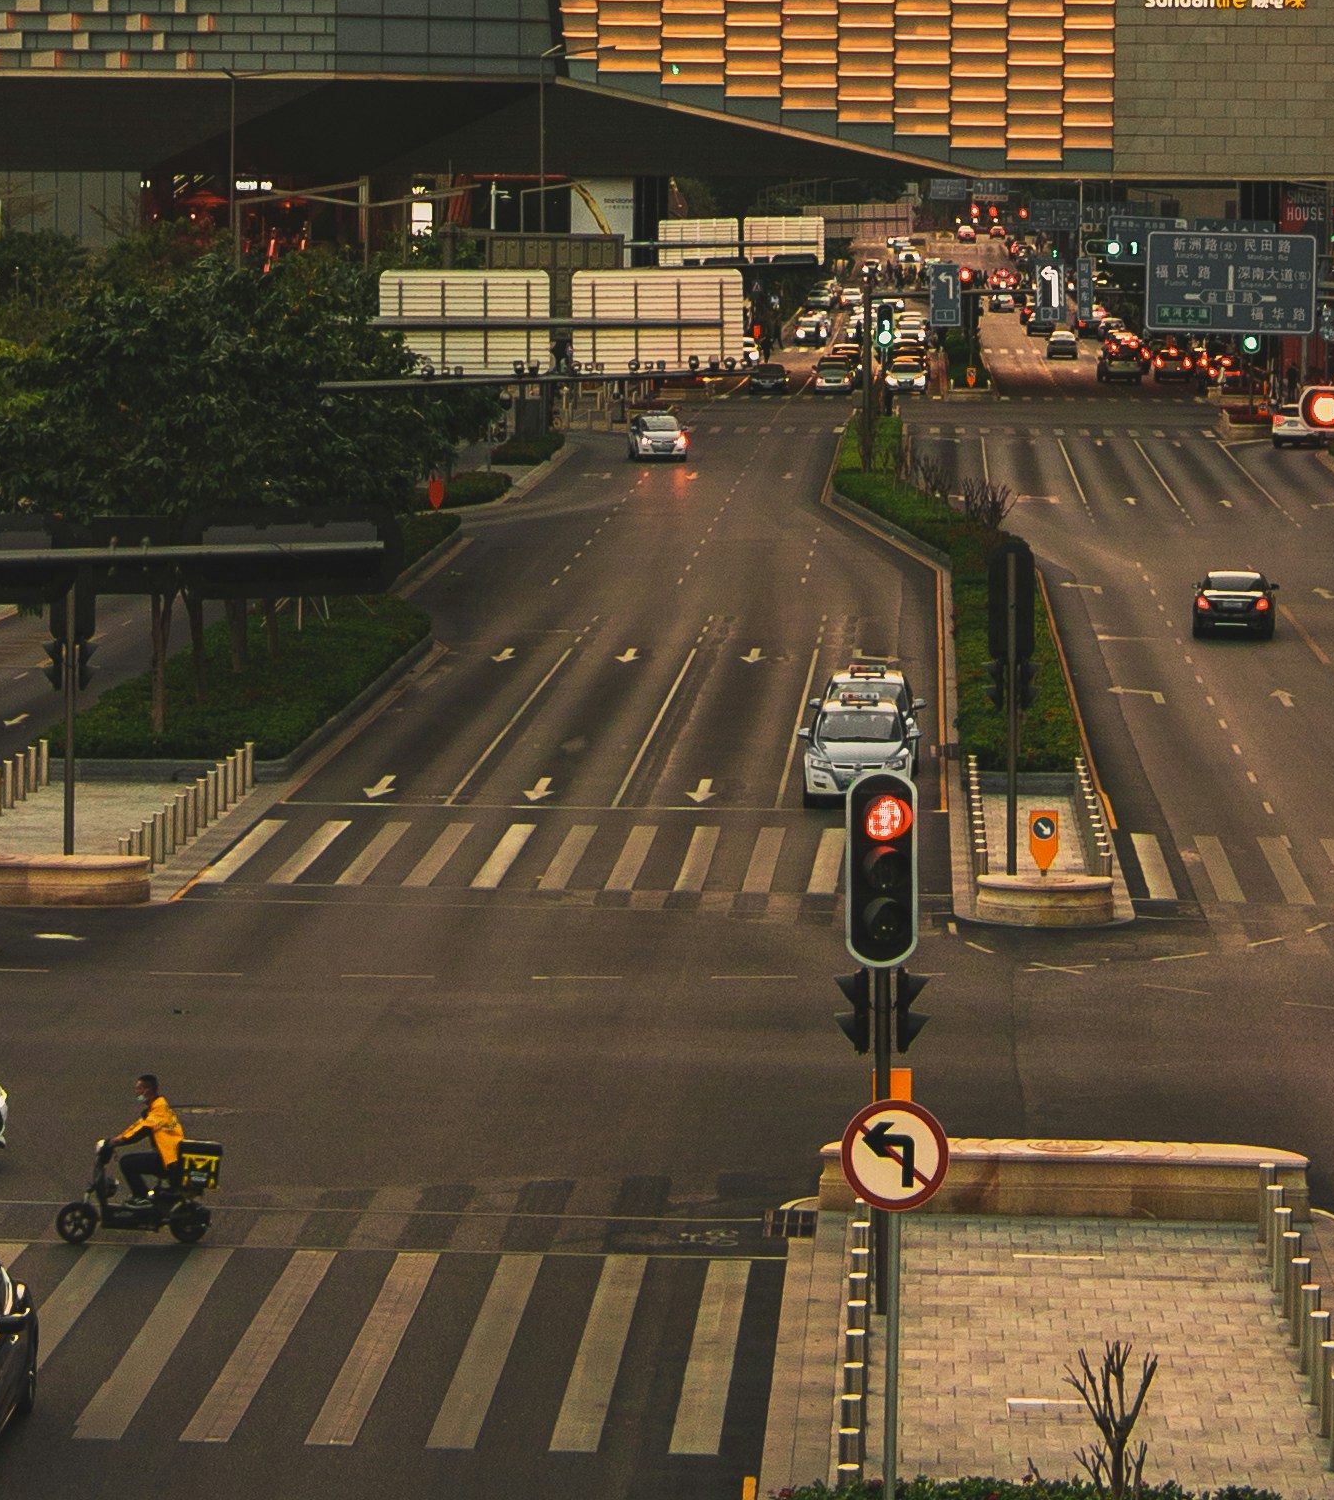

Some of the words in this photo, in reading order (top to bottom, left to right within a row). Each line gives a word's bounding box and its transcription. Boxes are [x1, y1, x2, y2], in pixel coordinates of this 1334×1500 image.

[1287, 206, 1325, 221] HOUSE
[1244, 238, 1291, 254] 民田路
[1155, 264, 1211, 279] 福民路
[1207, 291, 1254, 304] 益田路
[1251, 307, 1306, 321] 福华路
